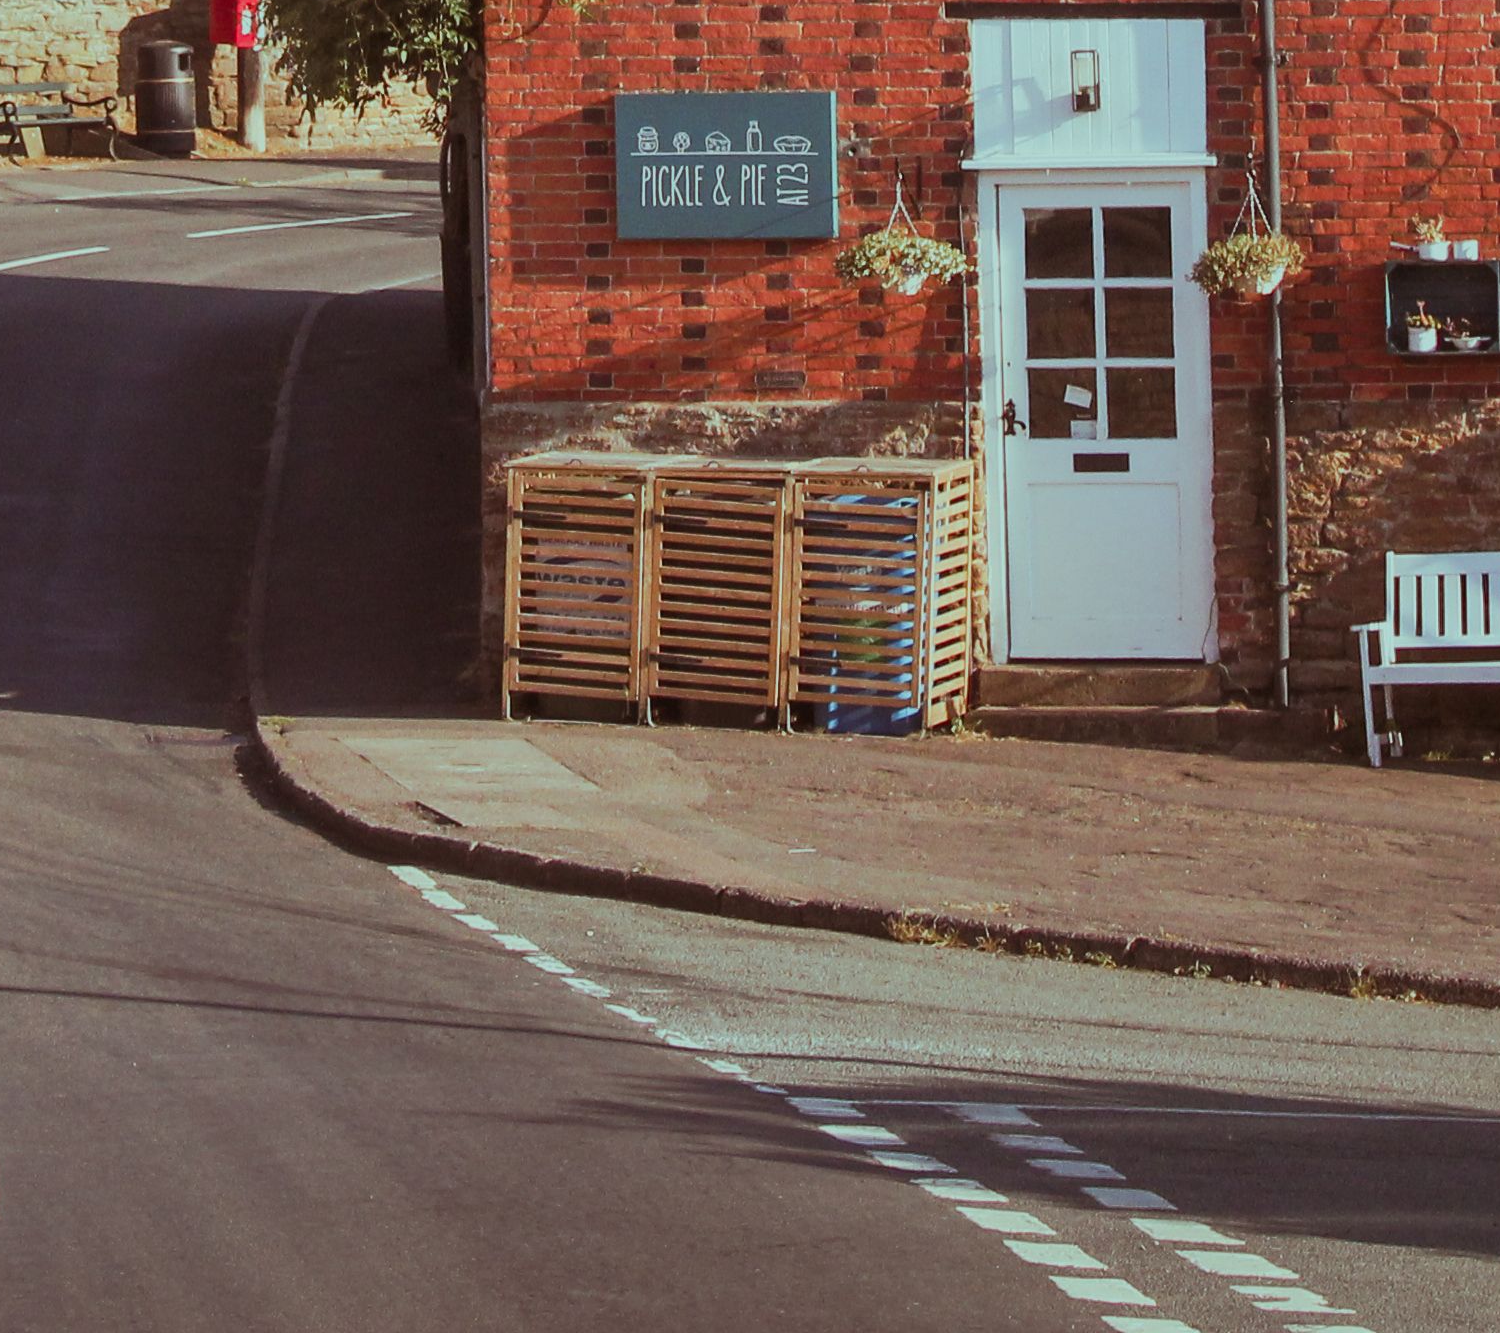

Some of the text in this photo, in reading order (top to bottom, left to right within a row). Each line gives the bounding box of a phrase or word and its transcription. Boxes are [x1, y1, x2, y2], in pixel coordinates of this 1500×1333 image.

[641, 164, 768, 207] PICKLE & PIE
[776, 163, 809, 206] AT 23
